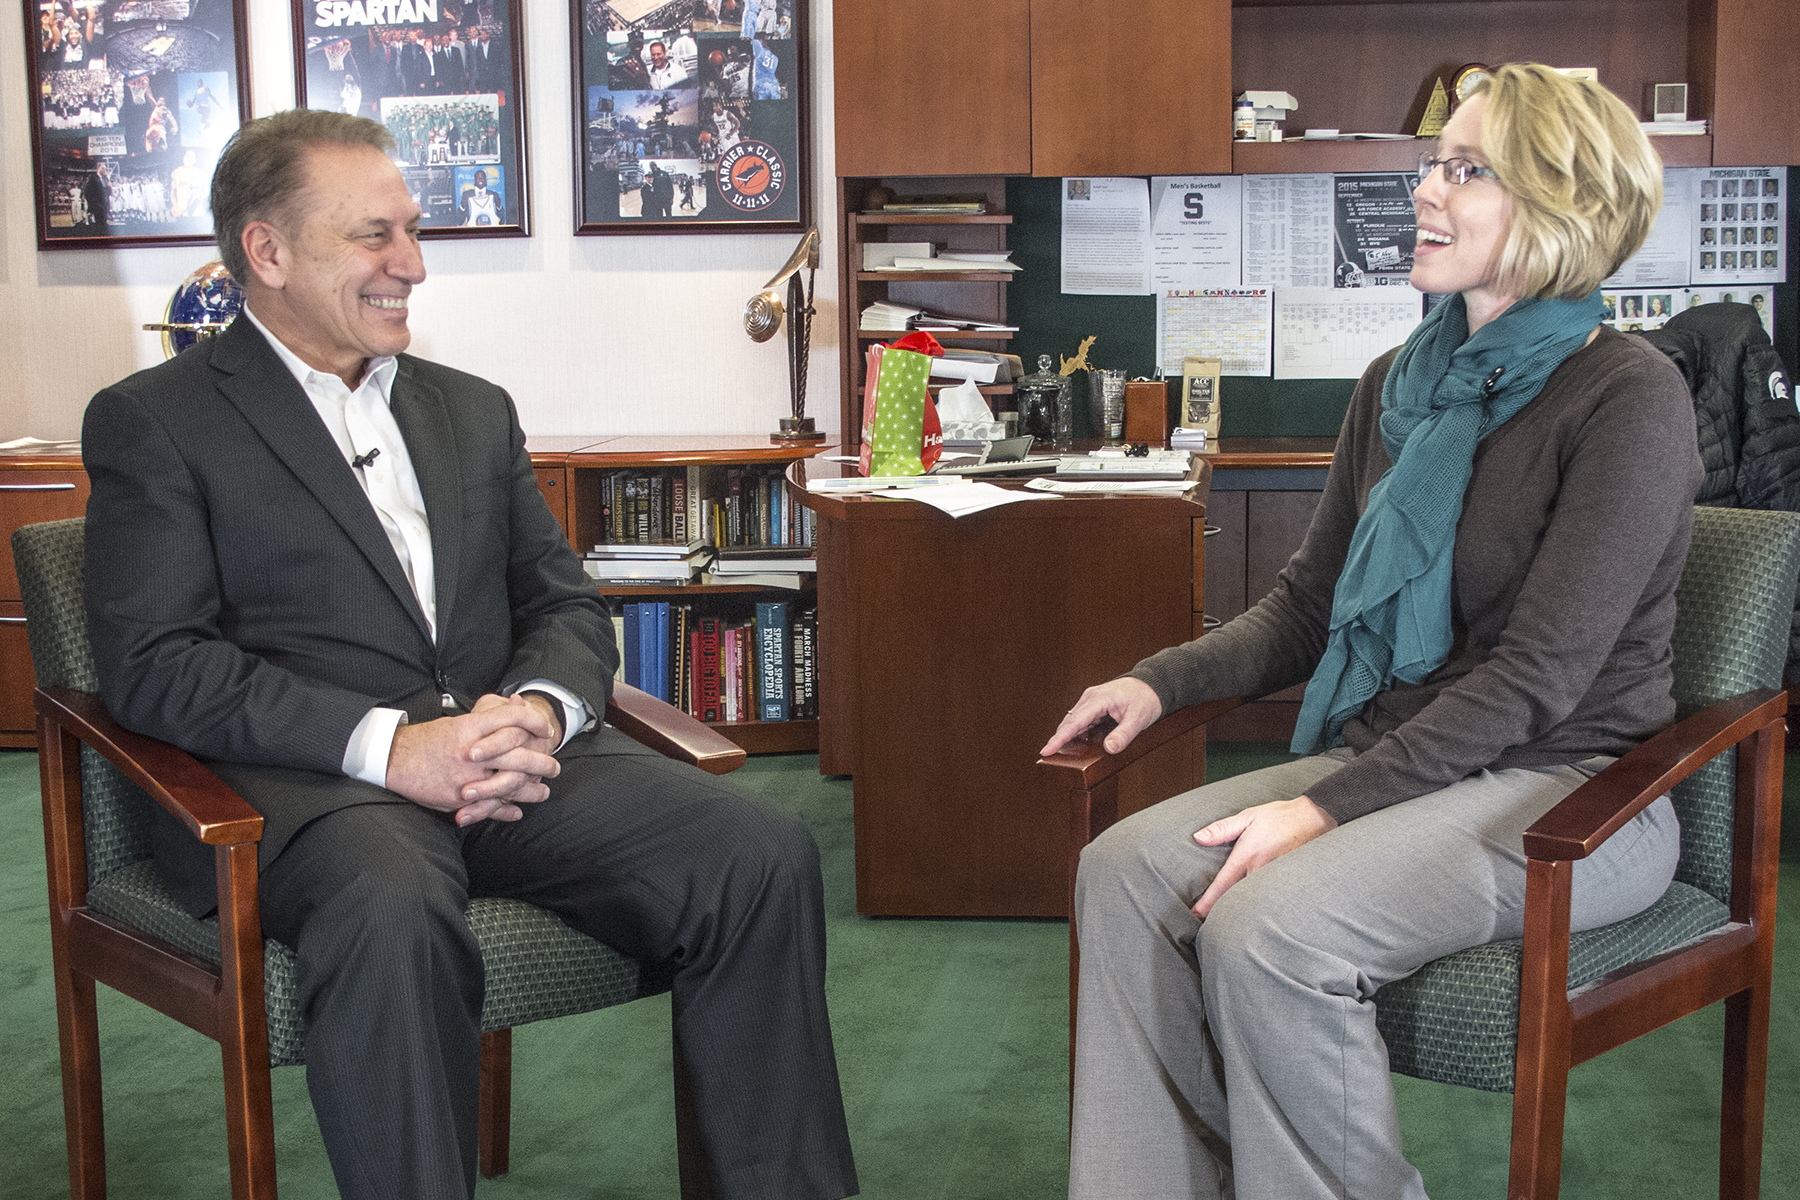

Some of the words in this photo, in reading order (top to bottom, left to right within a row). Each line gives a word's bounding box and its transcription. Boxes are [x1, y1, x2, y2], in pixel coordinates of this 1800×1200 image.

[315, 0, 438, 27] SPARTAN
[720, 146, 745, 191] CARRIER
[756, 145, 782, 190] CLASSIC
[1709, 170, 1747, 178] MICHIGAN
[1749, 169, 1771, 177] STATE
[1338, 182, 1358, 192] 2015
[1184, 193, 1203, 219] S
[675, 483, 684, 512] LOOSE
[638, 513, 648, 540] WILLIE
[703, 634, 717, 653] TOO
[773, 628, 783, 665] SPARTAN
[794, 635, 804, 664] FOURTH
[703, 655, 717, 674] BIG
[763, 628, 774, 700] ENCYCLOPEDIA
[795, 667, 804, 684] AND
[703, 676, 717, 688] TO
[774, 668, 784, 700] SPORTS
[804, 659, 812, 698] MADNESS
[703, 690, 717, 710] FAIL
[795, 685, 805, 705] LONG
